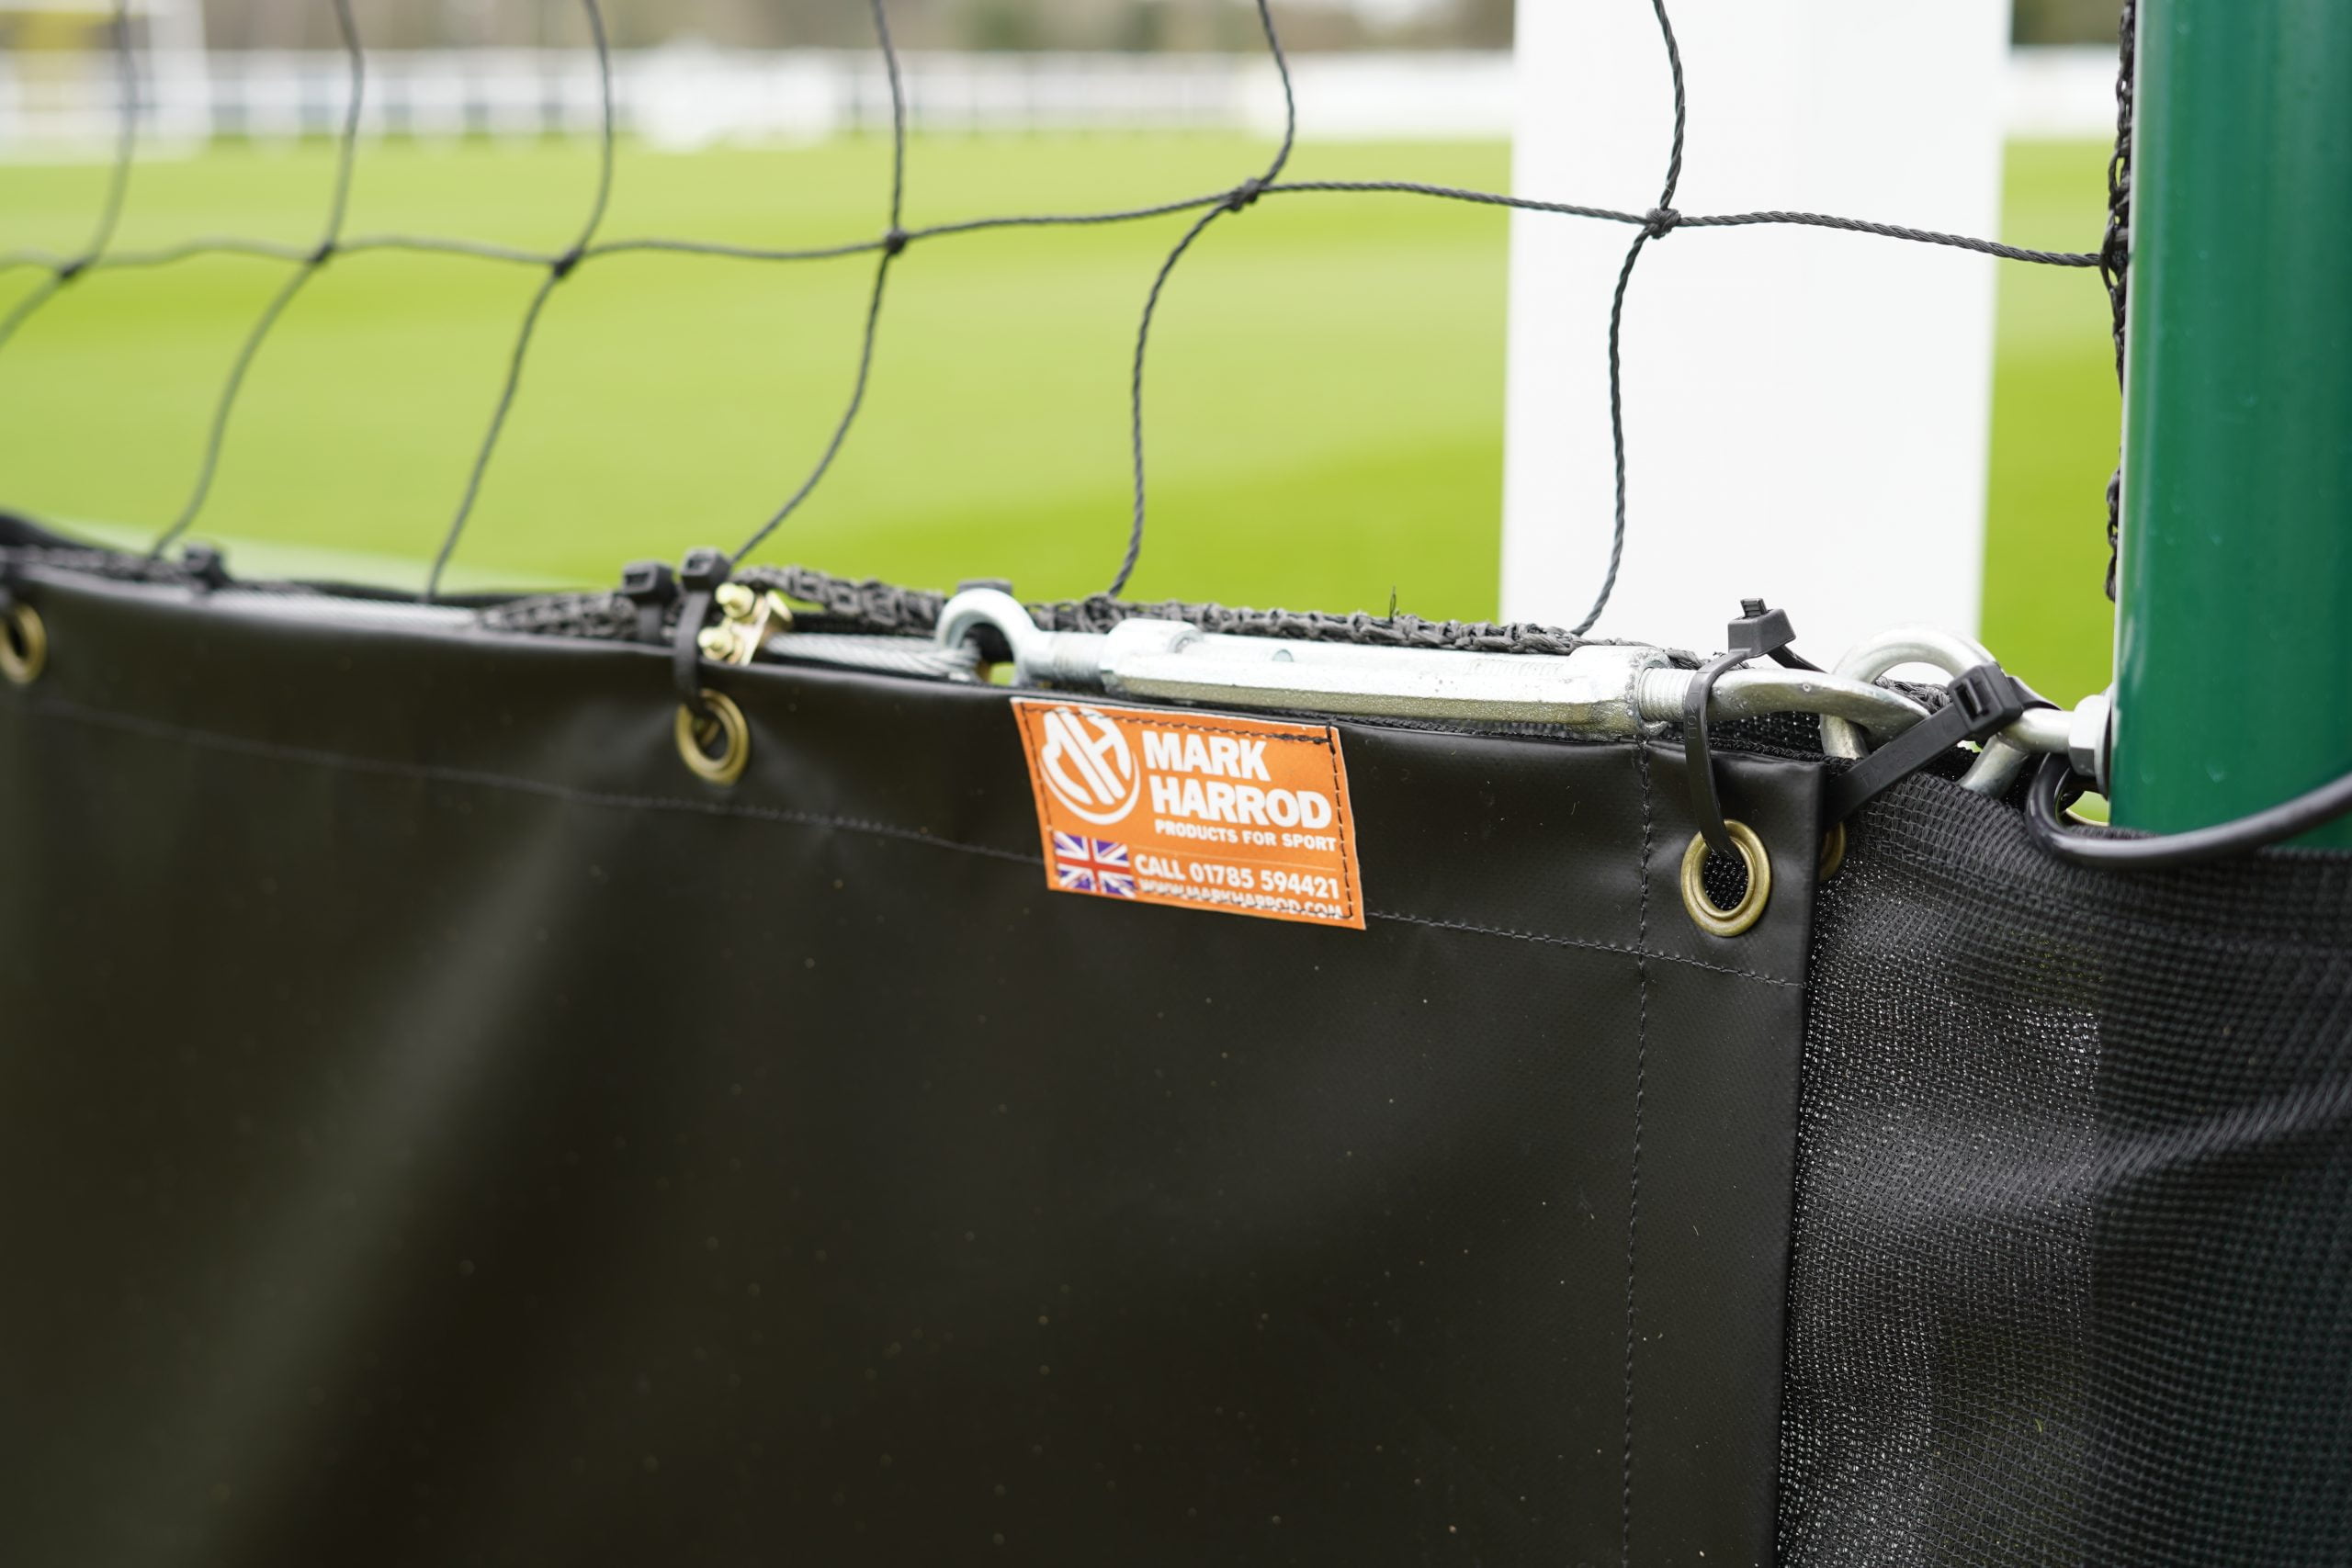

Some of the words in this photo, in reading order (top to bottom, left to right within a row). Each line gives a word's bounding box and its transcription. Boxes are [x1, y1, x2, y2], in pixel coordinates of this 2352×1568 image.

[1141, 730, 1271, 781] MARK
[1149, 776, 1332, 829] HARROD
[1155, 819, 1238, 844] PRODUCTS
[1243, 829, 1276, 847] FOR
[1282, 832, 1336, 852] SPORT
[1134, 854, 1185, 881] CALL
[1189, 863, 1253, 888] 01785
[1261, 871, 1340, 899] 594421
